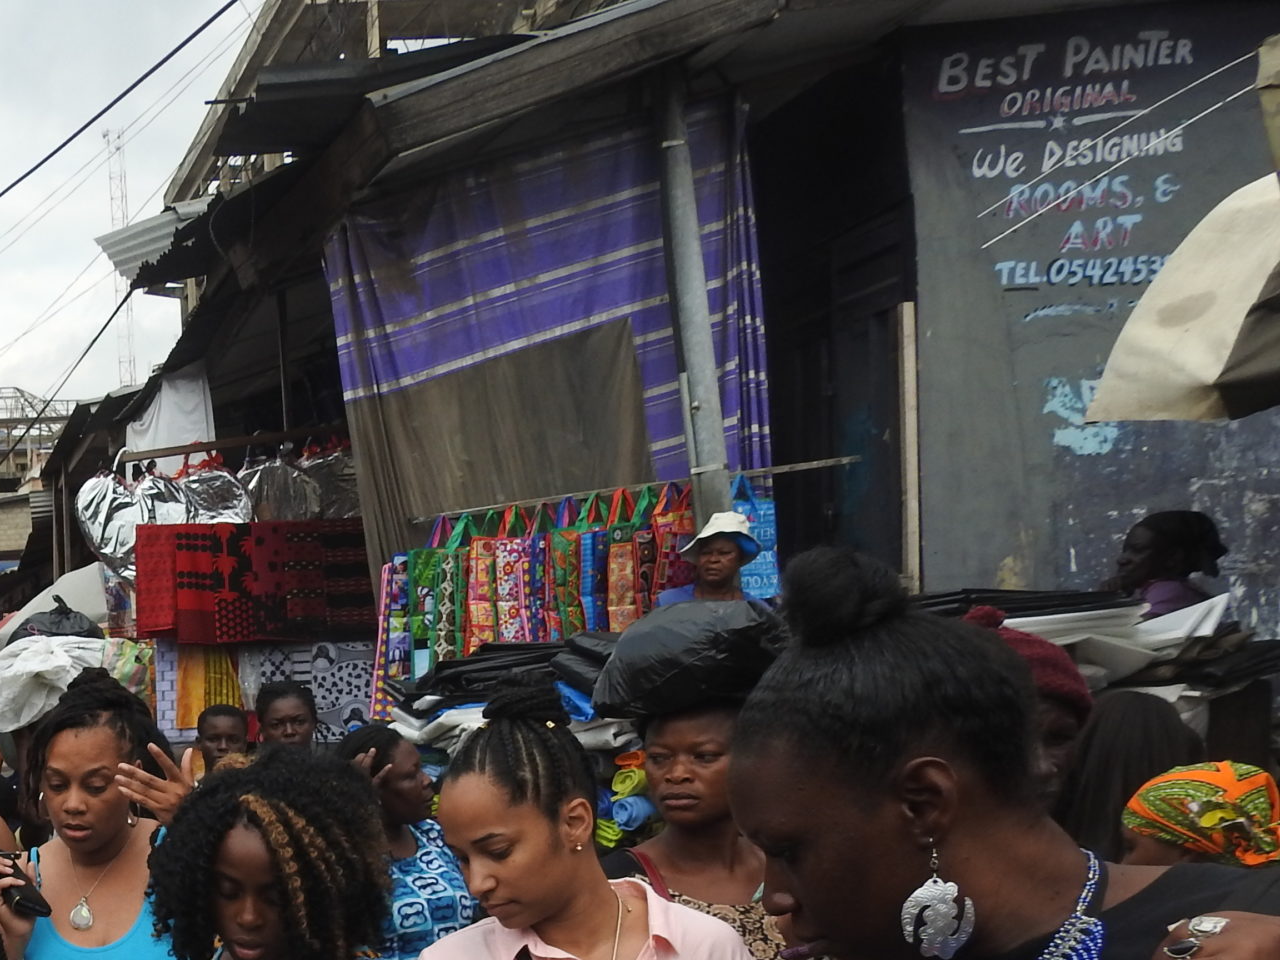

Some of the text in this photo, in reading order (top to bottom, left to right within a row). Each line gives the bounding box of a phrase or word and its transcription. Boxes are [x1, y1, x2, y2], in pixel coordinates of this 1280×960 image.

[937, 29, 1195, 94] BEST PAINTER
[999, 78, 1138, 118] ORIGINAL
[1041, 127, 1185, 176] DESIGNING
[1060, 213, 1143, 253] ART
